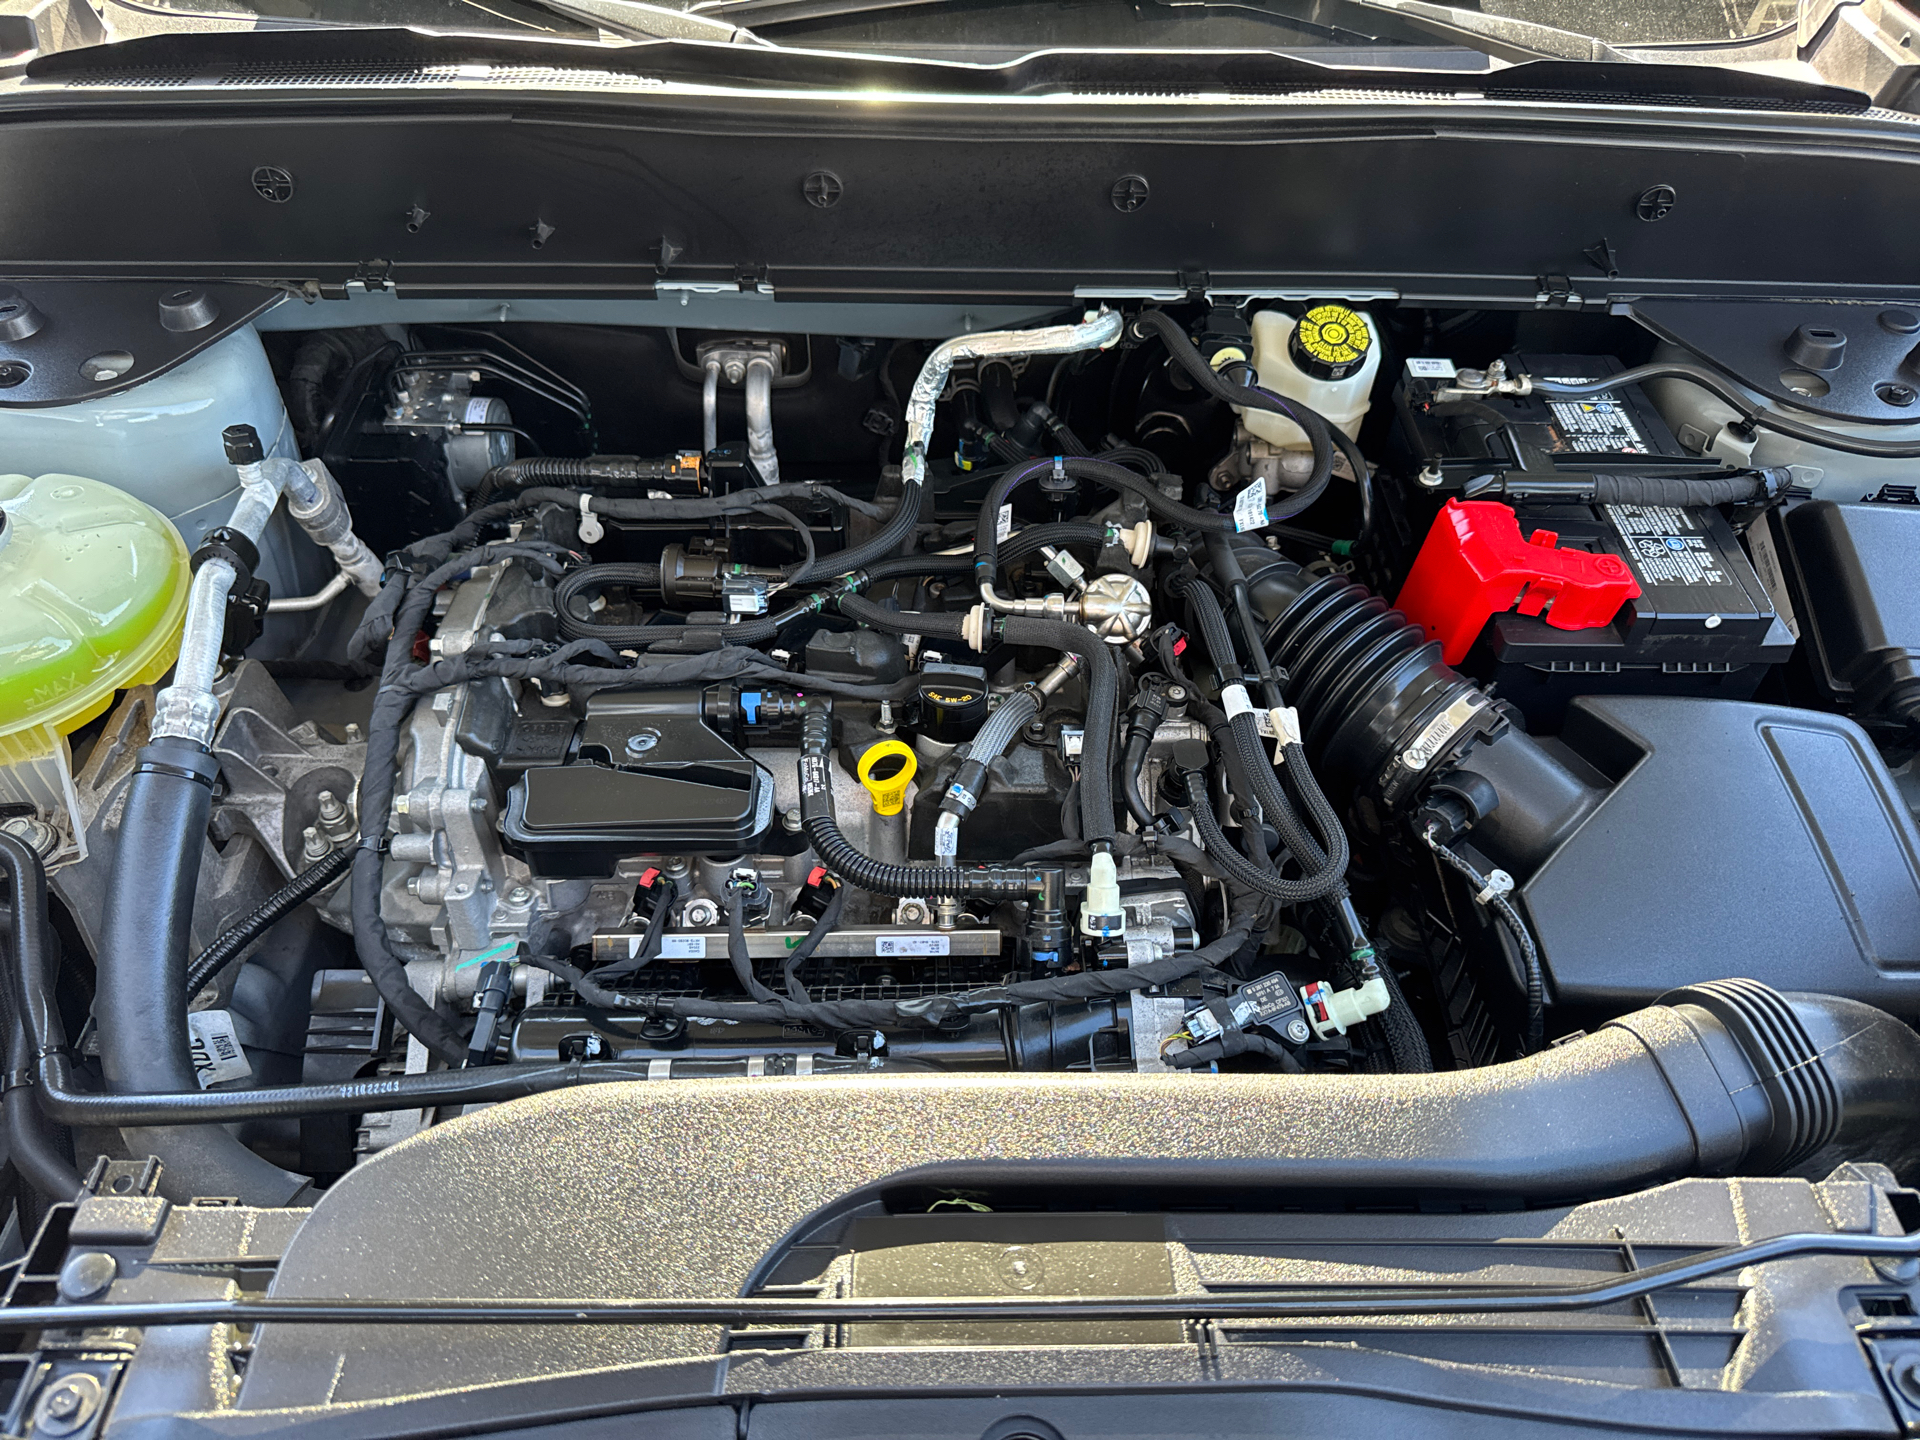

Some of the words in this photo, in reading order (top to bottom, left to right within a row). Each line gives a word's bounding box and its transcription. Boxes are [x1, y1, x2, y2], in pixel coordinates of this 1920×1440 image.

[34, 671, 85, 703] MAX
[928, 692, 942, 701] SAE
[945, 694, 972, 703] 5W-20
